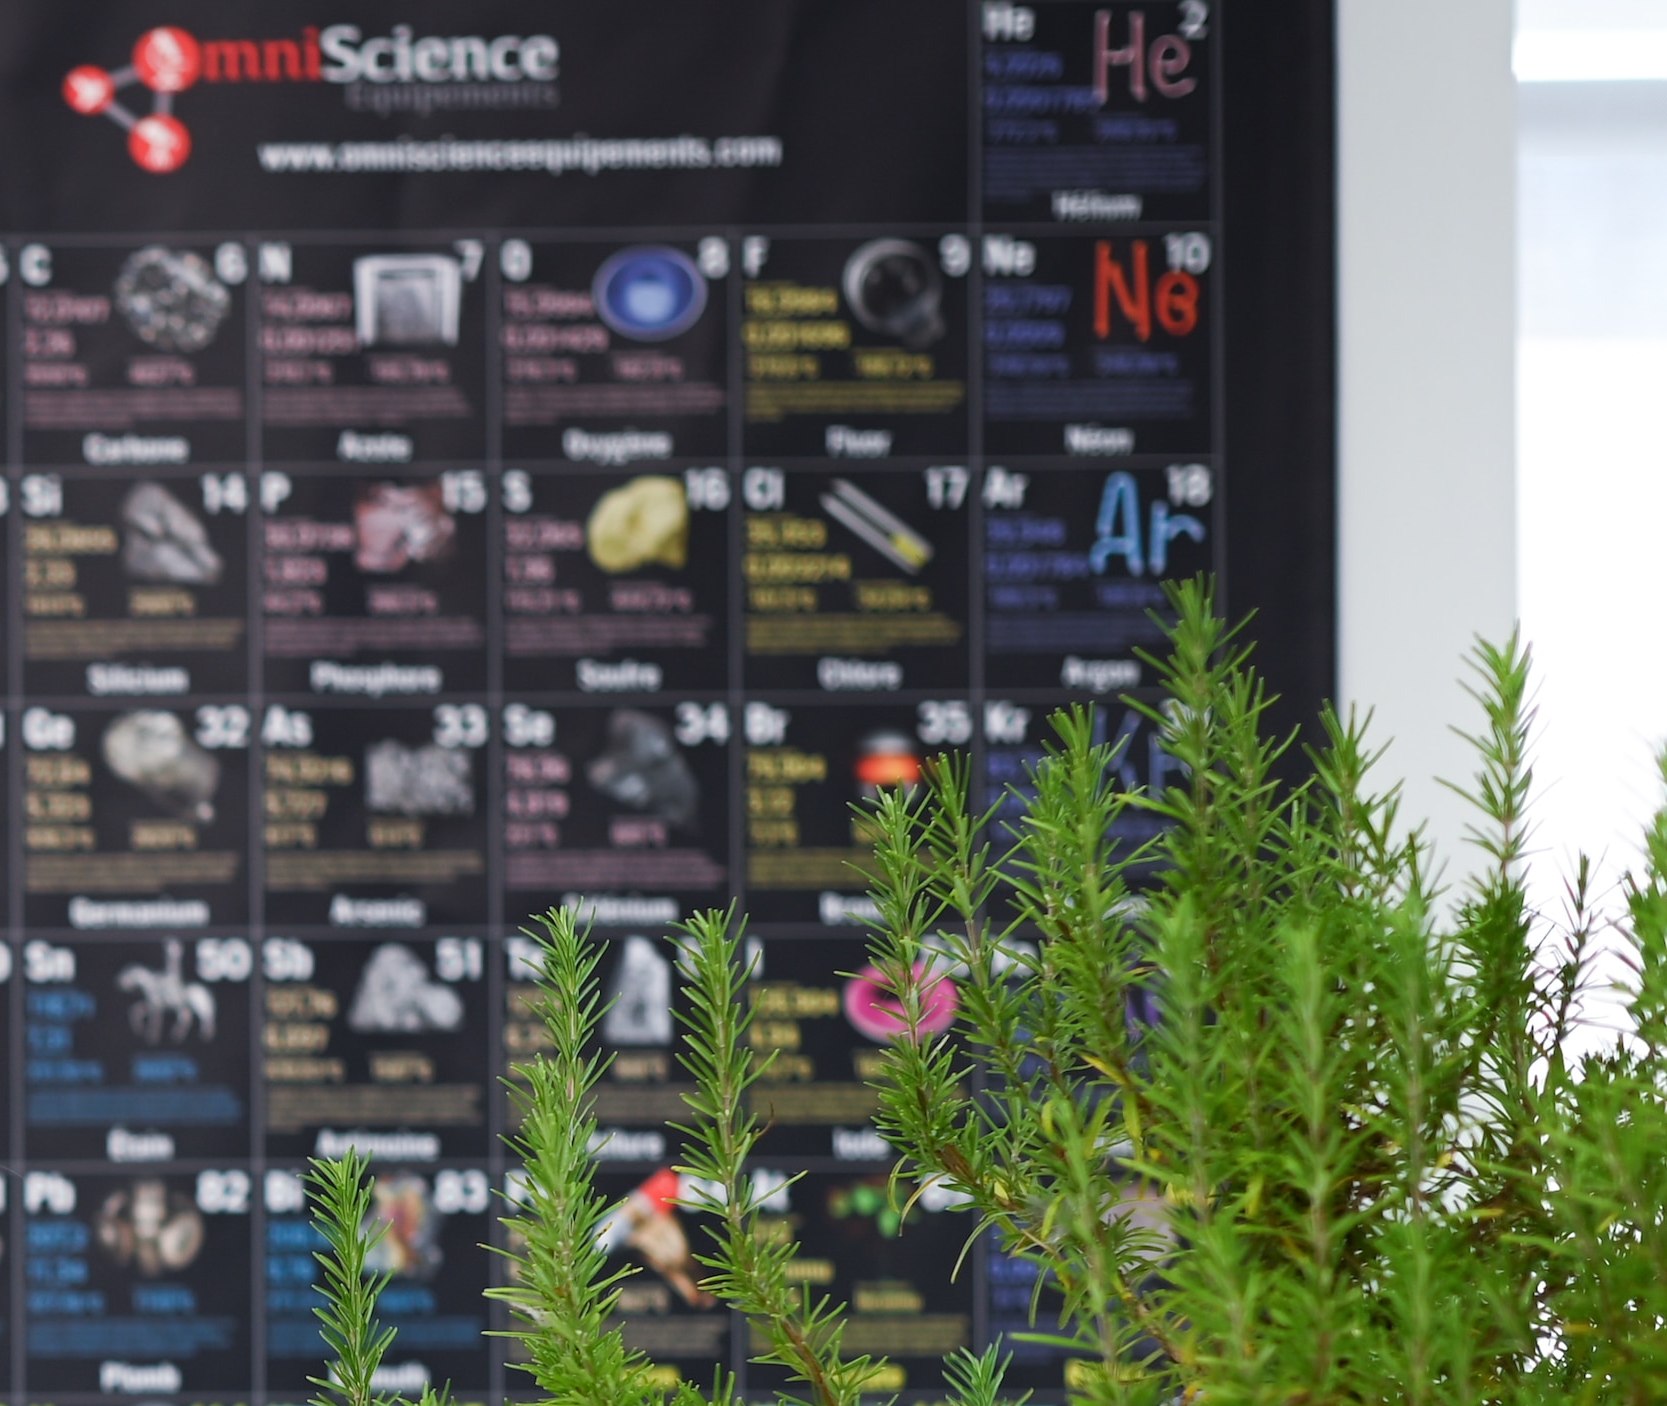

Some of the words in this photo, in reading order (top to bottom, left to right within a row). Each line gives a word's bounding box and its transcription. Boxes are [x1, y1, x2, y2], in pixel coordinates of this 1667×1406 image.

[983, 2, 1033, 38] He
[20, 244, 50, 285] C
[259, 243, 291, 280] N
[458, 240, 483, 279] 7
[743, 236, 765, 275] F
[941, 234, 971, 275] 9
[983, 236, 1034, 274] Ne
[22, 475, 61, 515] Si
[203, 473, 248, 511] 14
[260, 472, 290, 511] P
[442, 470, 486, 514] 15
[503, 470, 531, 511] S
[744, 468, 783, 509] Cl
[926, 466, 970, 507] 17
[983, 467, 1025, 506] Ar
[22, 708, 74, 749] Ge
[195, 705, 250, 749] 32
[261, 705, 311, 746] As
[433, 704, 487, 748] 33
[504, 704, 553, 746] Se
[677, 702, 730, 744] 34
[745, 702, 791, 744] Br
[24, 941, 75, 982] Sn
[197, 938, 253, 982] 50
[436, 938, 482, 980] 51
[24, 1172, 75, 1213] Pb
[197, 1170, 250, 1214] 82
[264, 1170, 304, 1212] Bi
